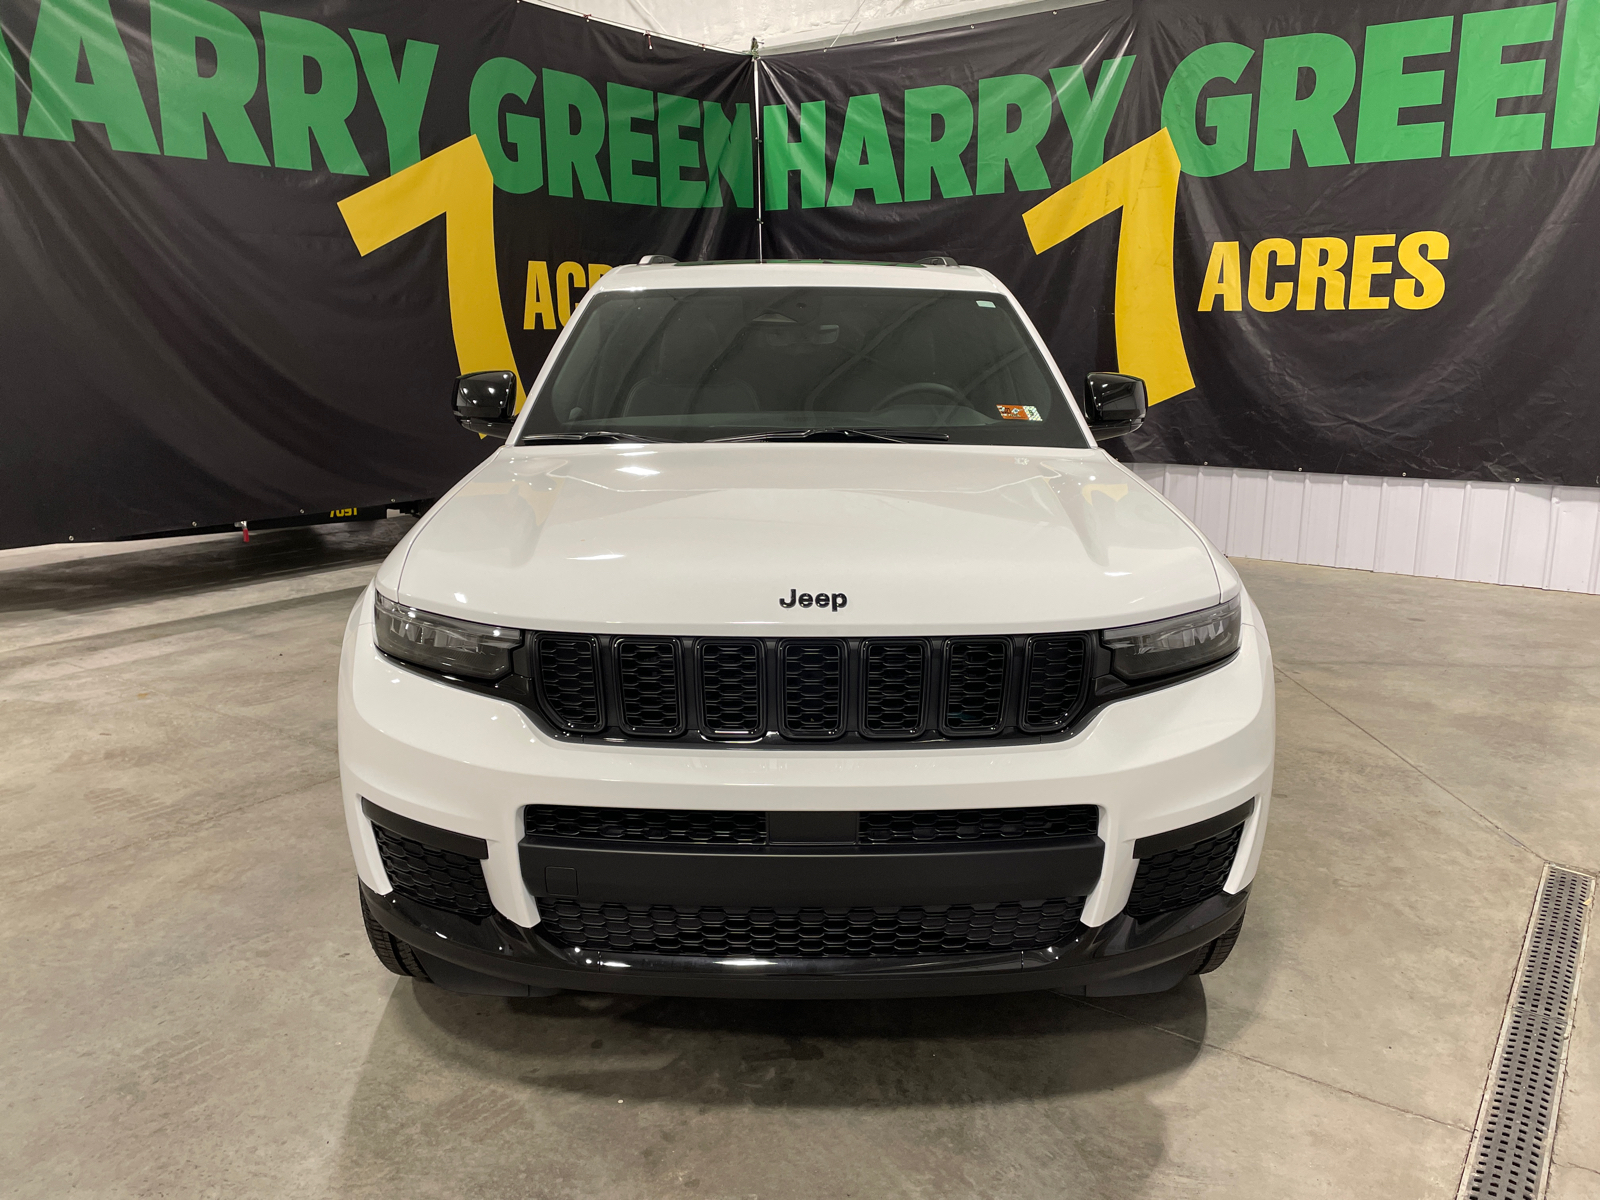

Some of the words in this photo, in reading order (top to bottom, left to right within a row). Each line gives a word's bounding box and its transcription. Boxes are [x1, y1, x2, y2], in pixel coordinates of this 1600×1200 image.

[0, 0, 439, 177] ARRY
[469, 57, 755, 209] GREEN
[763, 55, 1137, 211] HARRY
[337, 134, 527, 440] 7
[1022, 127, 1196, 405] 7
[1198, 230, 1450, 313] ACRES
[779, 588, 848, 612] Jeep
